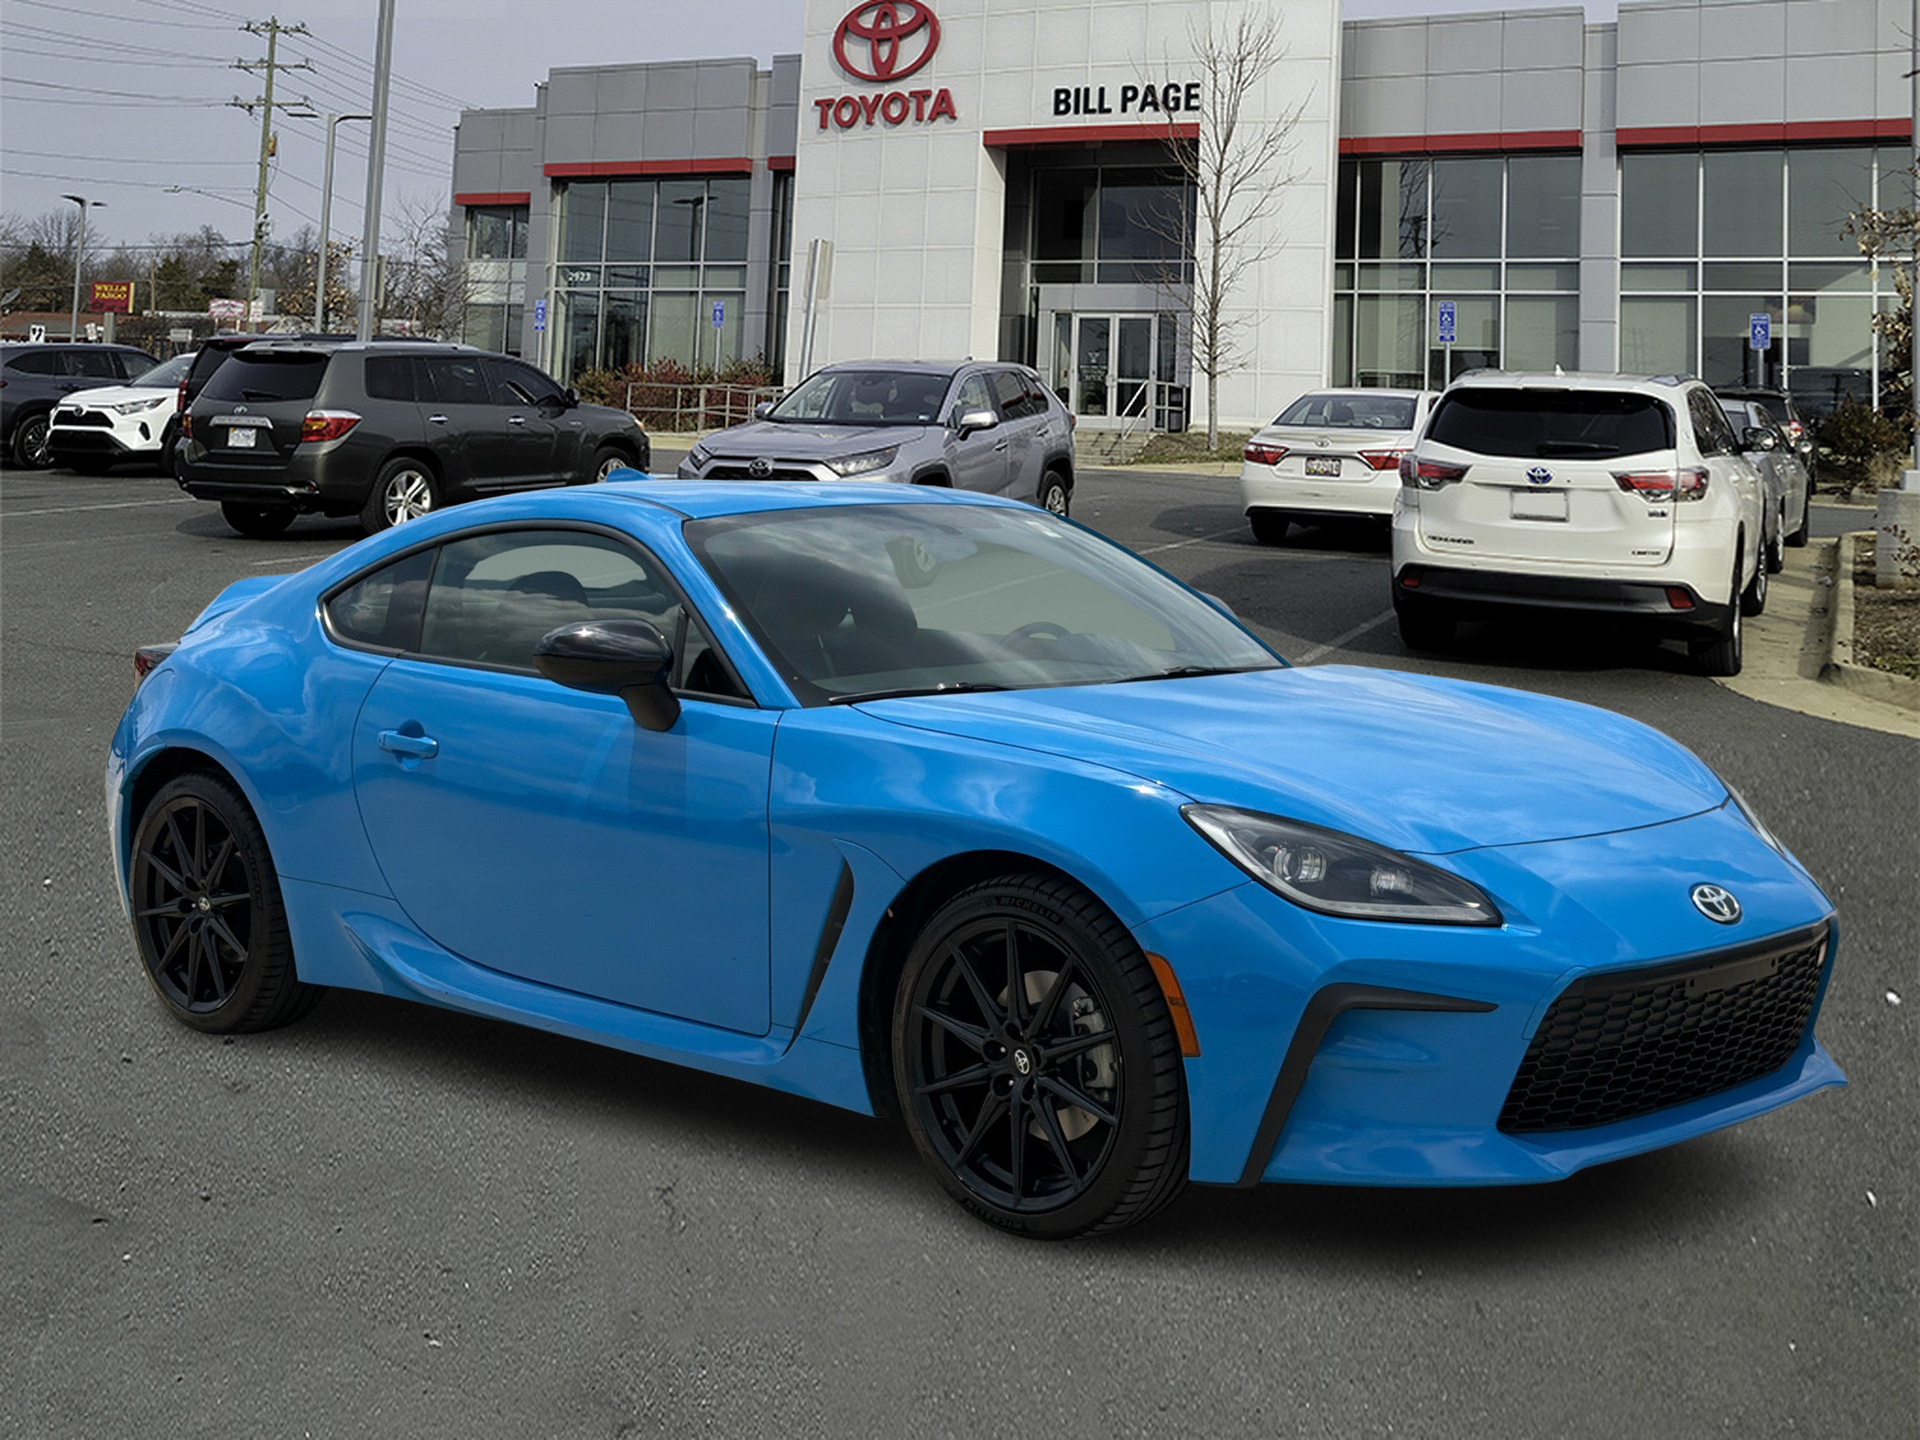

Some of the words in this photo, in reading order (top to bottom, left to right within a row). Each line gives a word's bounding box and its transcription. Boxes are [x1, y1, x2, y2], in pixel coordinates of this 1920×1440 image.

[814, 88, 957, 130] TOYOTA
[1053, 86, 1112, 117] BILL
[1120, 83, 1200, 113] PAGE
[94, 284, 128, 292] WELLS
[94, 292, 127, 300] FARGO
